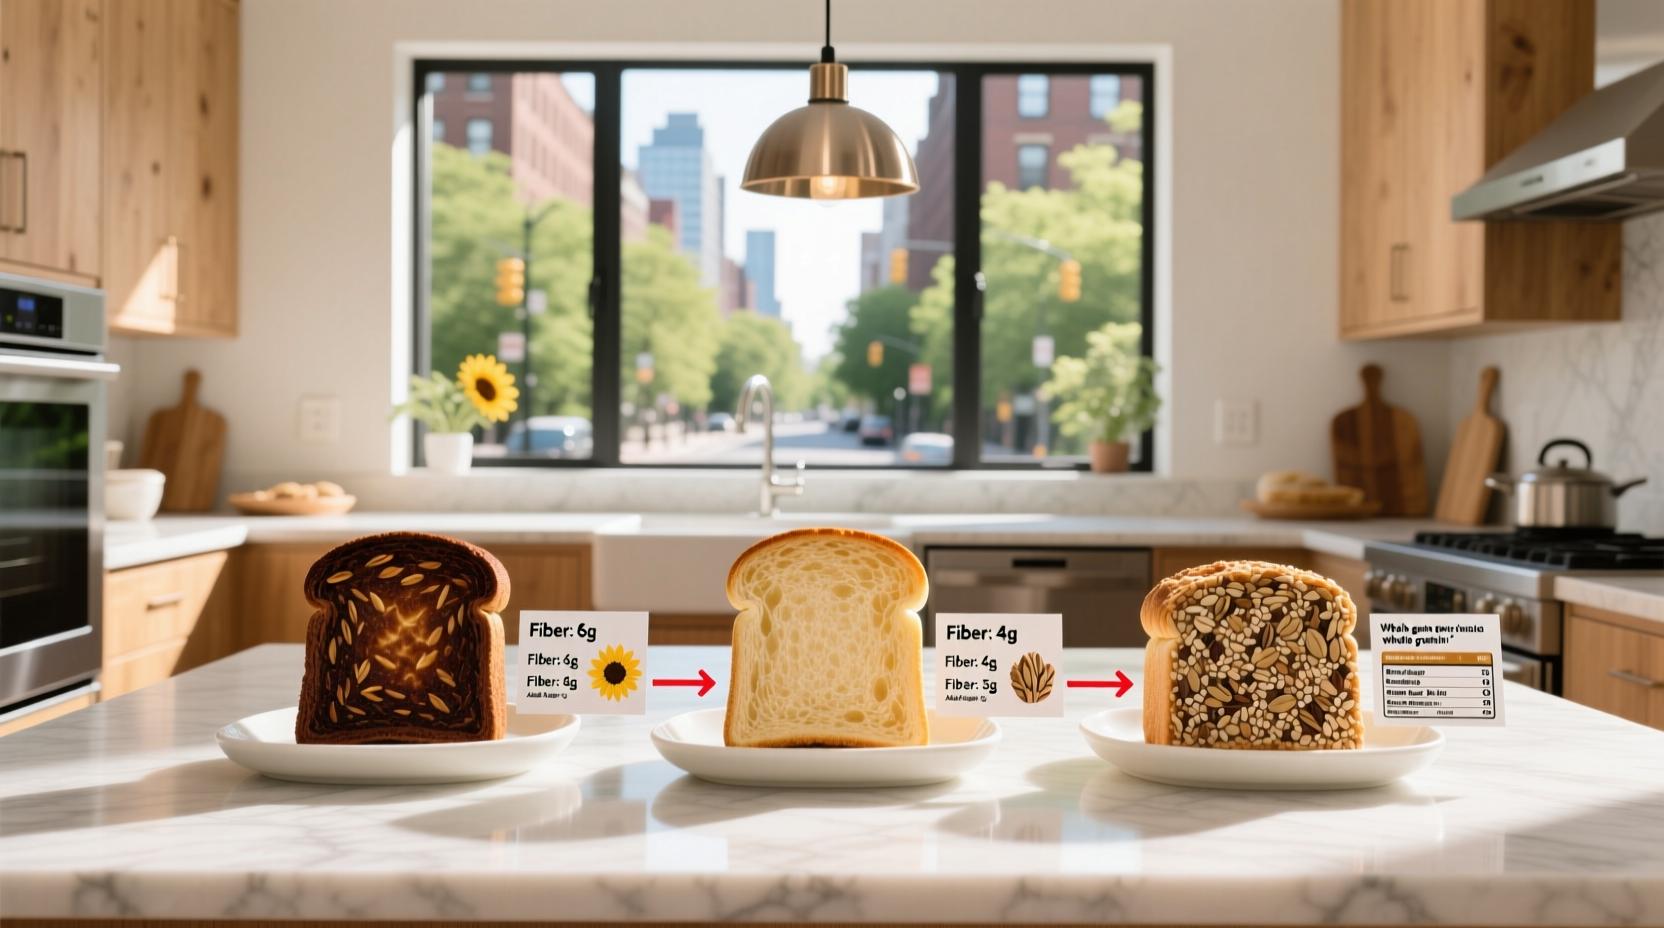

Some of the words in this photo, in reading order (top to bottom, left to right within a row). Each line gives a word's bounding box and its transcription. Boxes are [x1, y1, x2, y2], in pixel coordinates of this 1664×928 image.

[529, 622, 574, 638] Fiber:
[577, 622, 597, 643] 6g
[946, 624, 993, 640] Fiber:
[996, 625, 1018, 645] 4g
[562, 653, 579, 670] 6g
[981, 655, 998, 672] 4g
